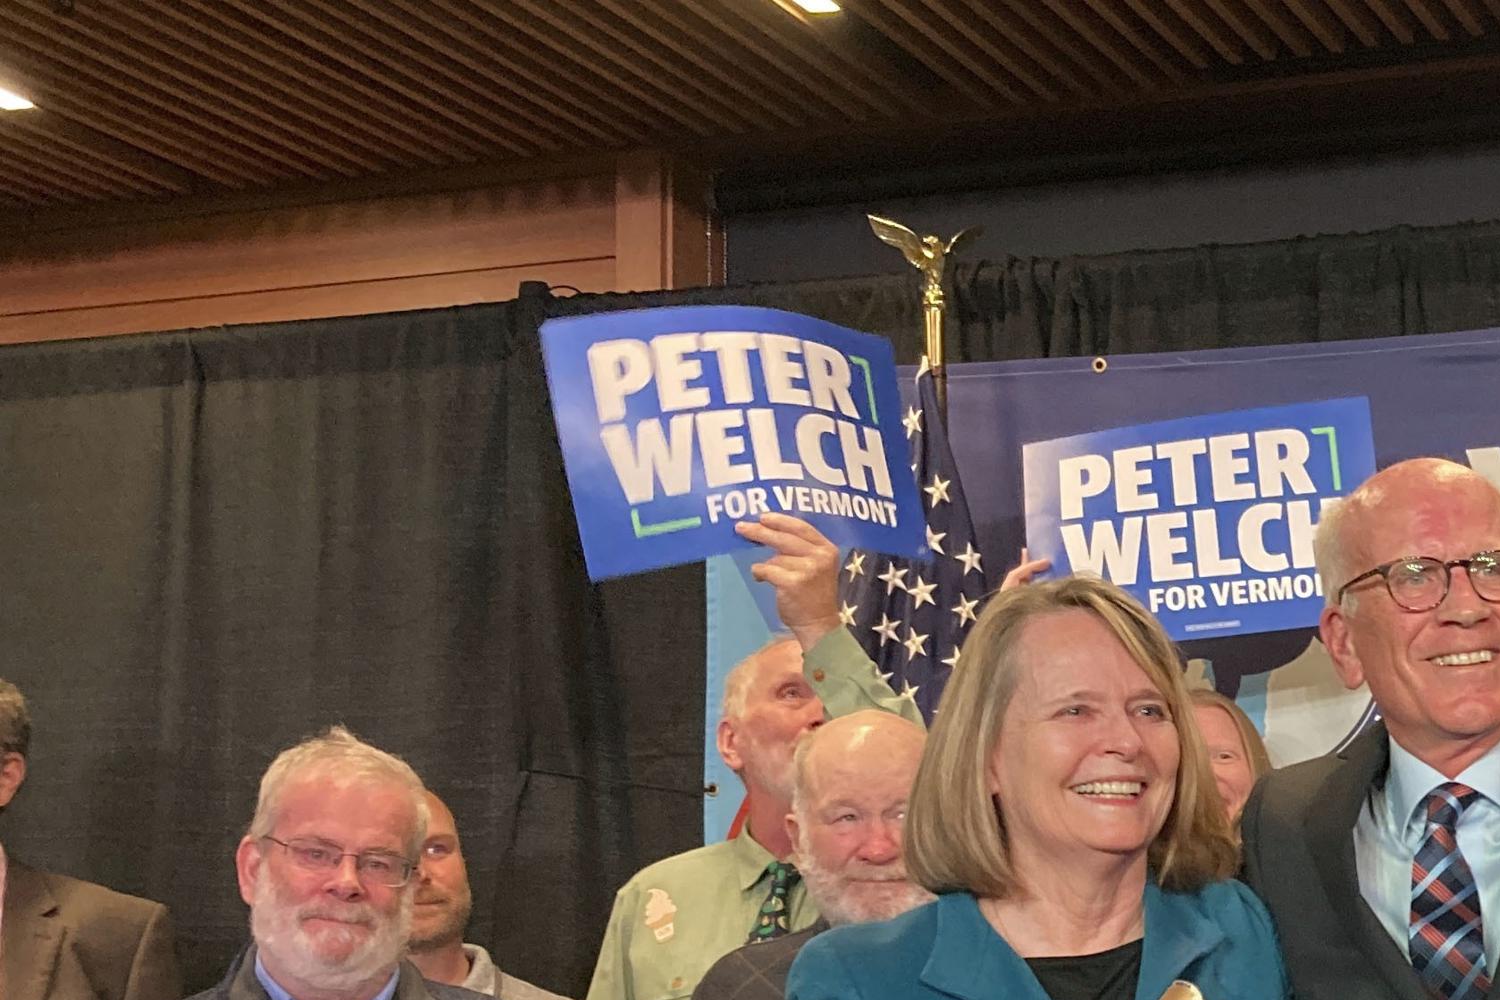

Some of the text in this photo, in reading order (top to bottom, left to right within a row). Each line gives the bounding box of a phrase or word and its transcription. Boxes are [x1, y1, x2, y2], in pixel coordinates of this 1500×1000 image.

[587, 331, 860, 423] PETER
[601, 408, 894, 503] WELCH
[1058, 428, 1316, 520] PETER
[705, 486, 898, 528] FOR VERMONT
[1060, 497, 1343, 586] WELCH
[1149, 573, 1324, 613] FOR VERMO
